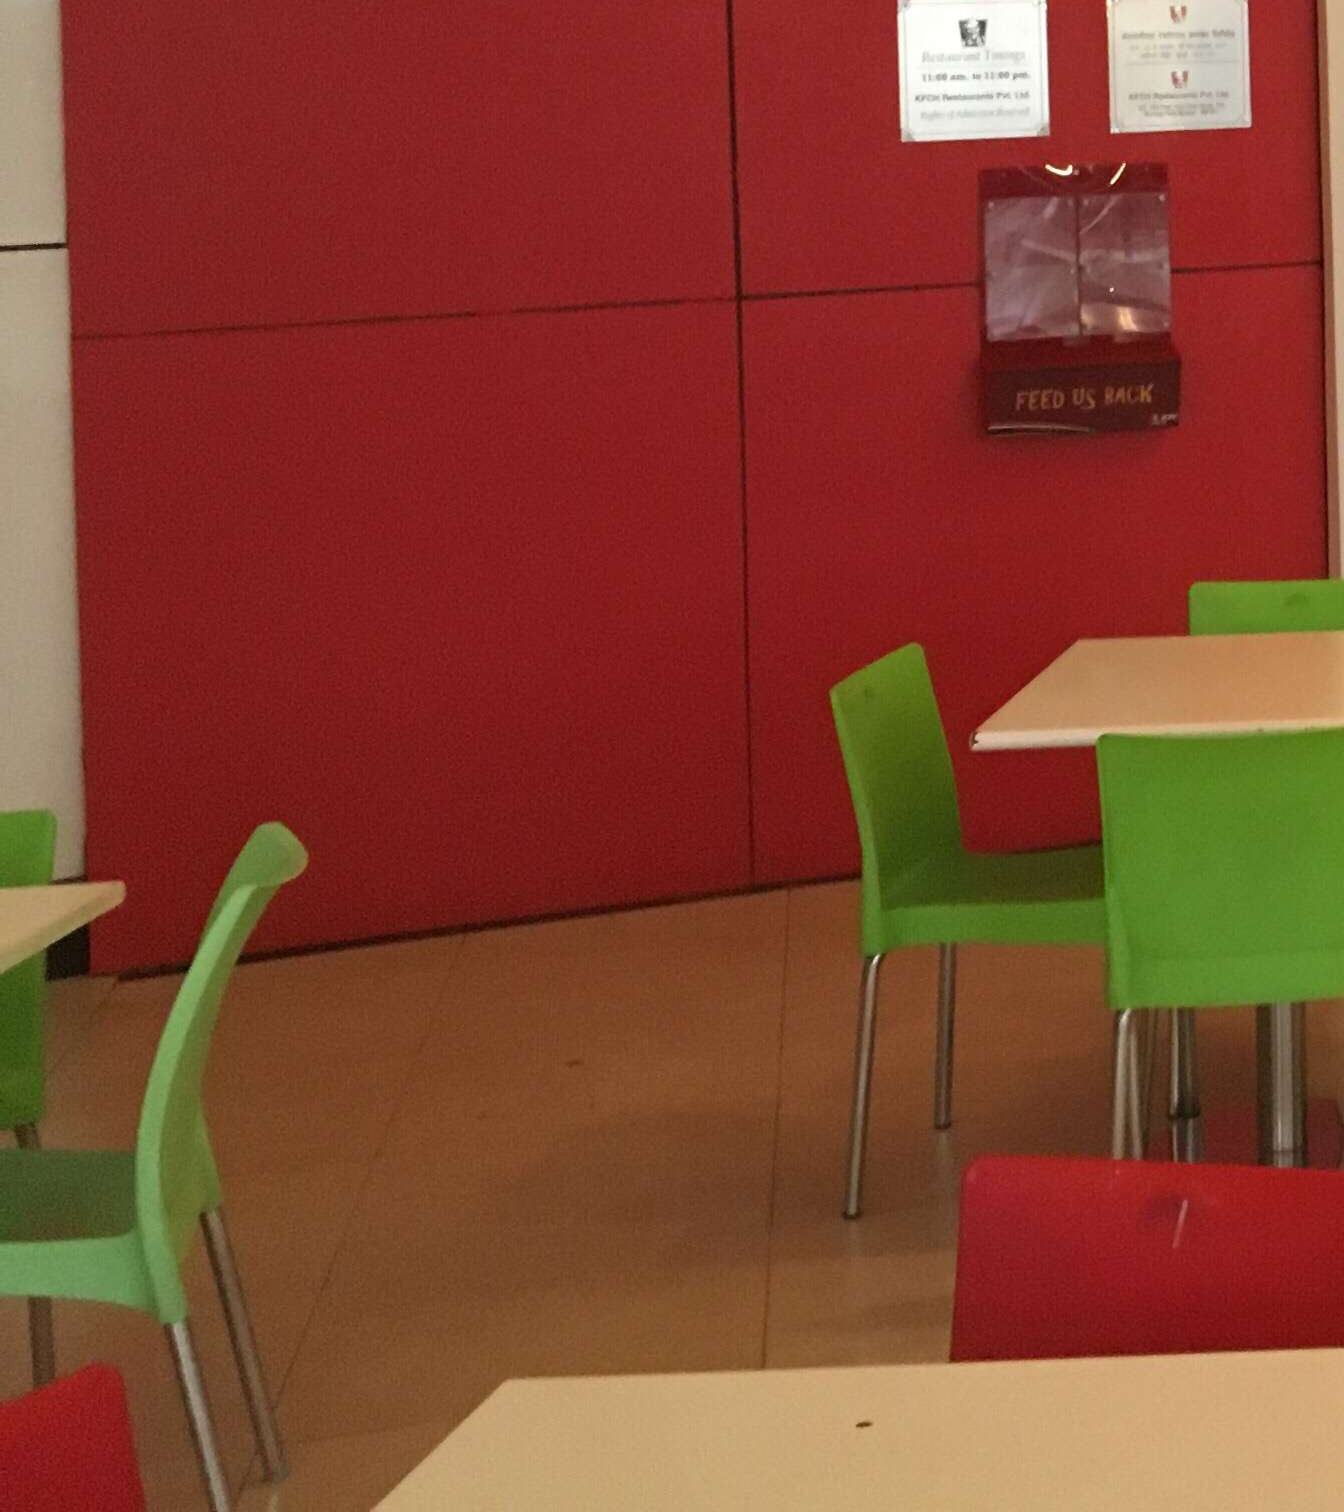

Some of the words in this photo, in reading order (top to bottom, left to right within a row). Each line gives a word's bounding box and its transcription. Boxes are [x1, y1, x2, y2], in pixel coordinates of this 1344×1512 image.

[1015, 389, 1066, 411] FEED
[1072, 387, 1096, 410] US
[1103, 383, 1155, 406] BACK
